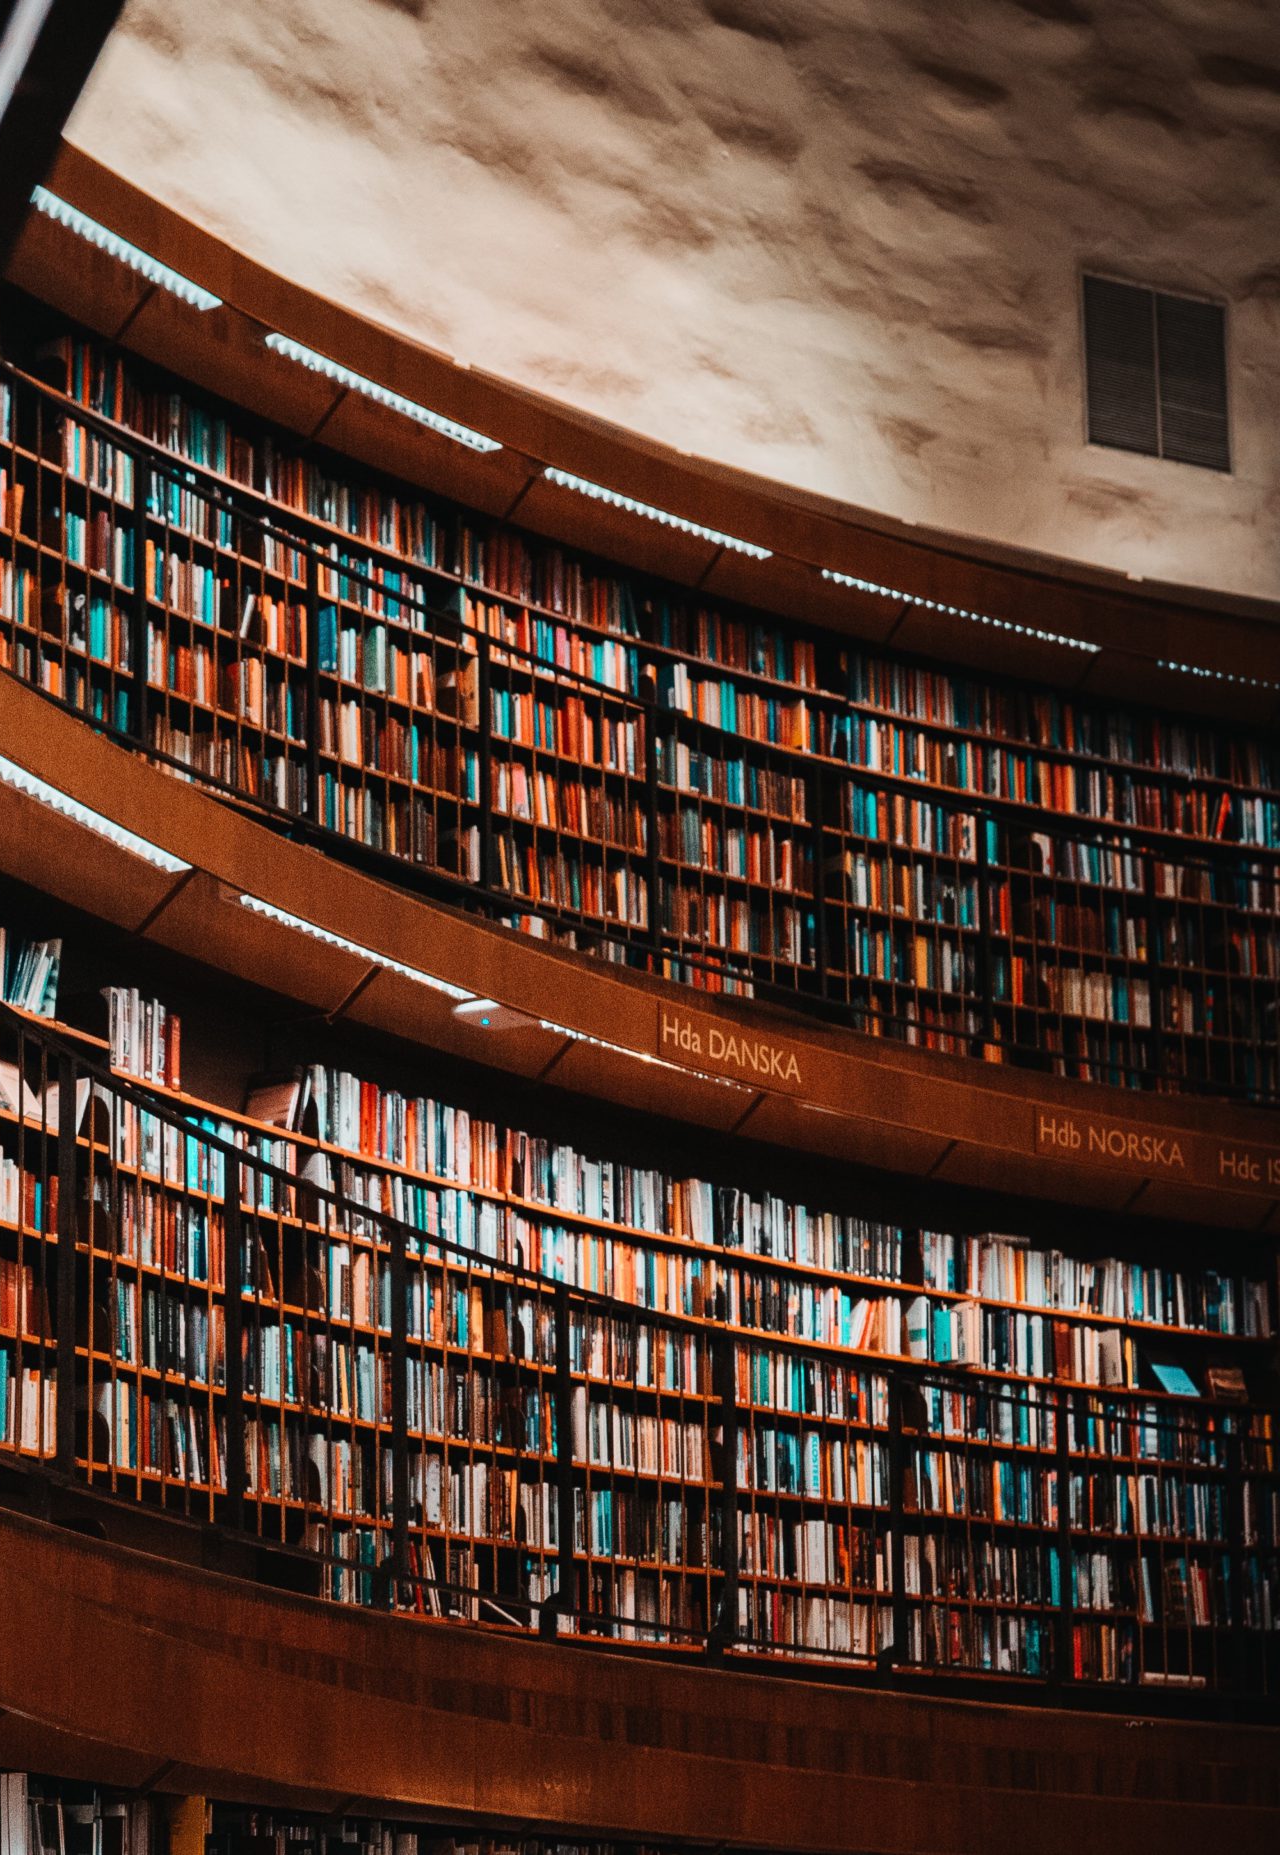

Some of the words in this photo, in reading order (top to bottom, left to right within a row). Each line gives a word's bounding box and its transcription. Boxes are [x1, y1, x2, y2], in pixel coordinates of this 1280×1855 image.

[662, 1013, 702, 1055] Hda
[709, 1028, 802, 1083] DANSKA
[1039, 1115, 1081, 1149] Hdb
[1088, 1125, 1185, 1168] NORSKA
[1220, 1150, 1262, 1181] Hdc
